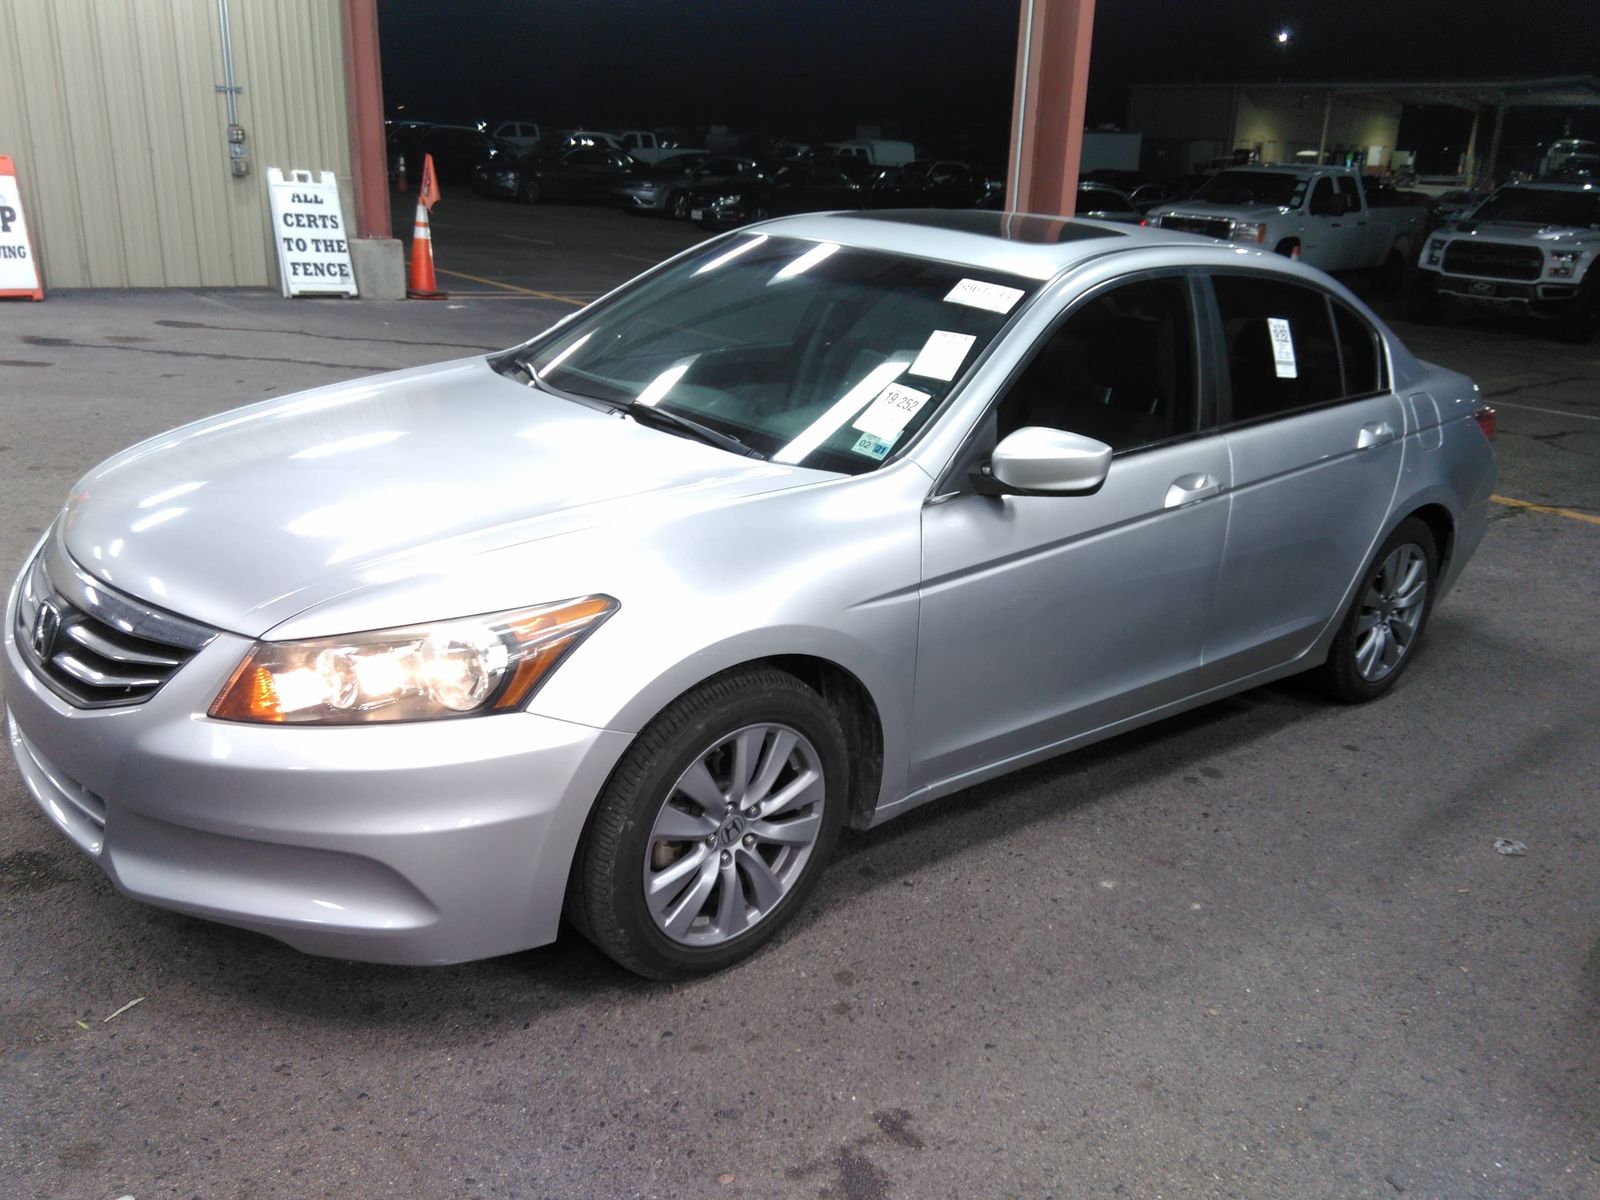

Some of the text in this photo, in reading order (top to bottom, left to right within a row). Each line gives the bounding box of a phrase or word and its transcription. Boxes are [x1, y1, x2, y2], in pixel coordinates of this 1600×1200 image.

[291, 193, 324, 204] ALL
[282, 212, 339, 229] CERTS
[283, 237, 347, 253] TO THE
[290, 262, 349, 277] FENCE
[859, 439, 872, 449] 02
